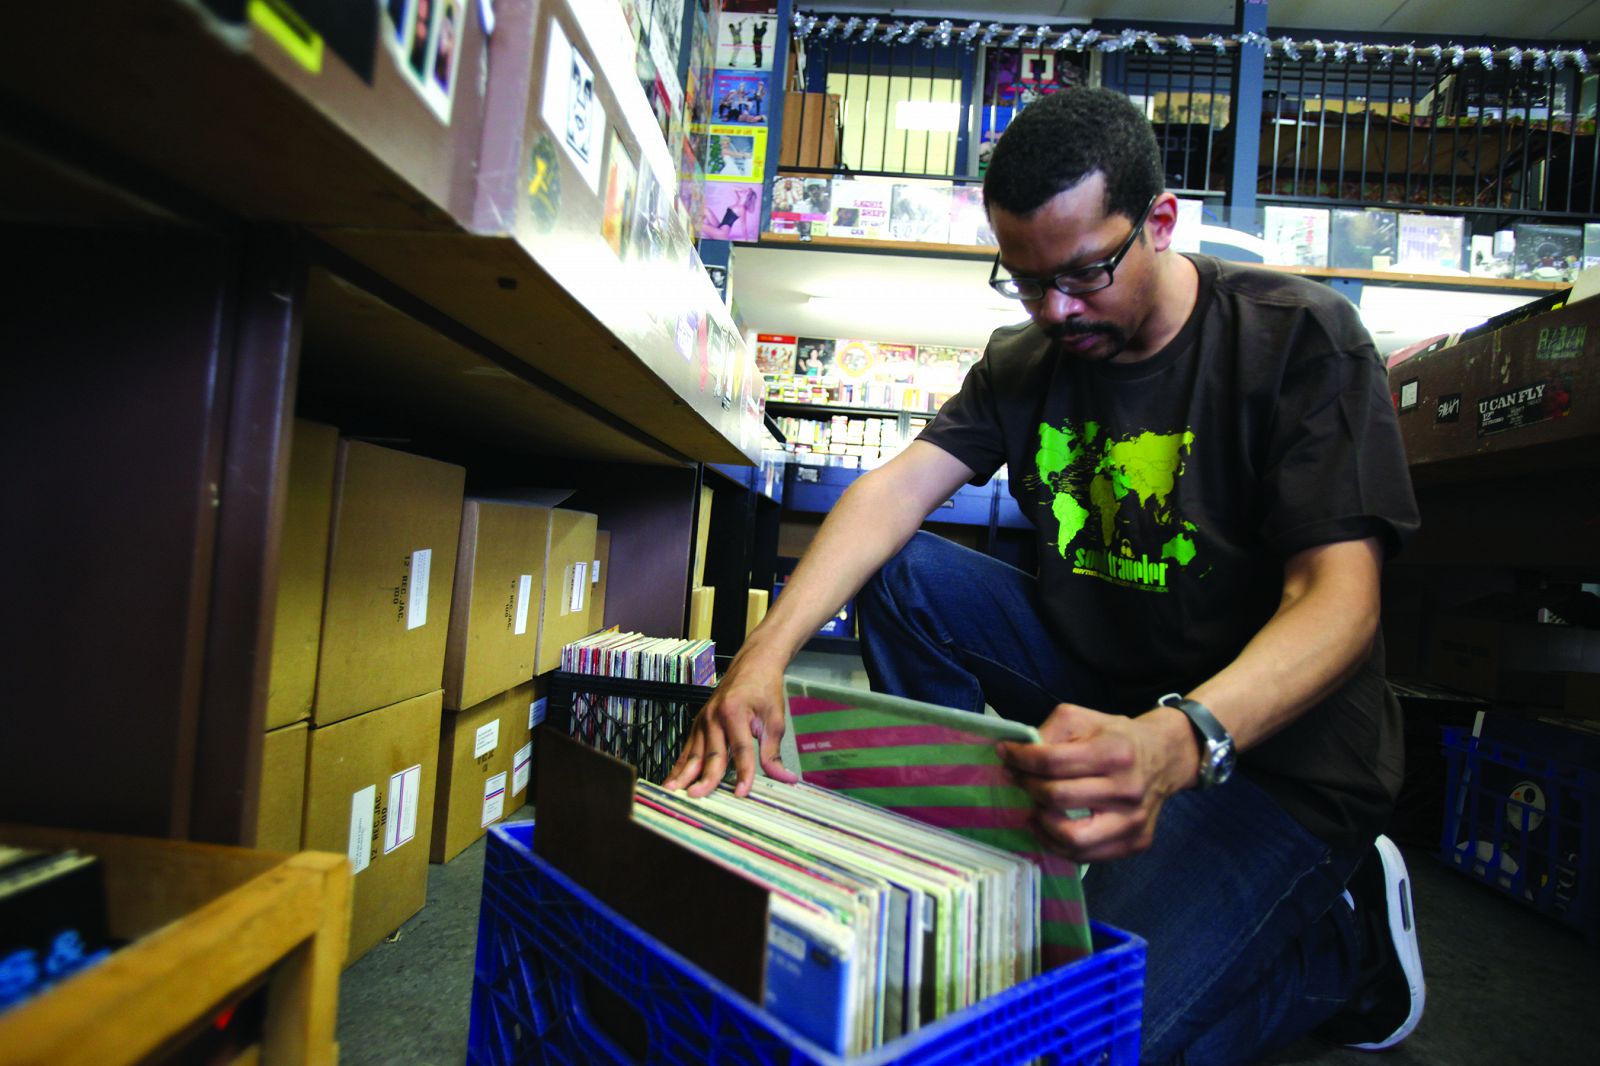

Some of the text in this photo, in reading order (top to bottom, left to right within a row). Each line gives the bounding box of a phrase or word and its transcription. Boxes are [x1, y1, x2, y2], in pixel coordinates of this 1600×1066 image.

[1479, 401, 1489, 414] U
[1489, 393, 1517, 411] CAN
[1518, 384, 1546, 403] FLY
